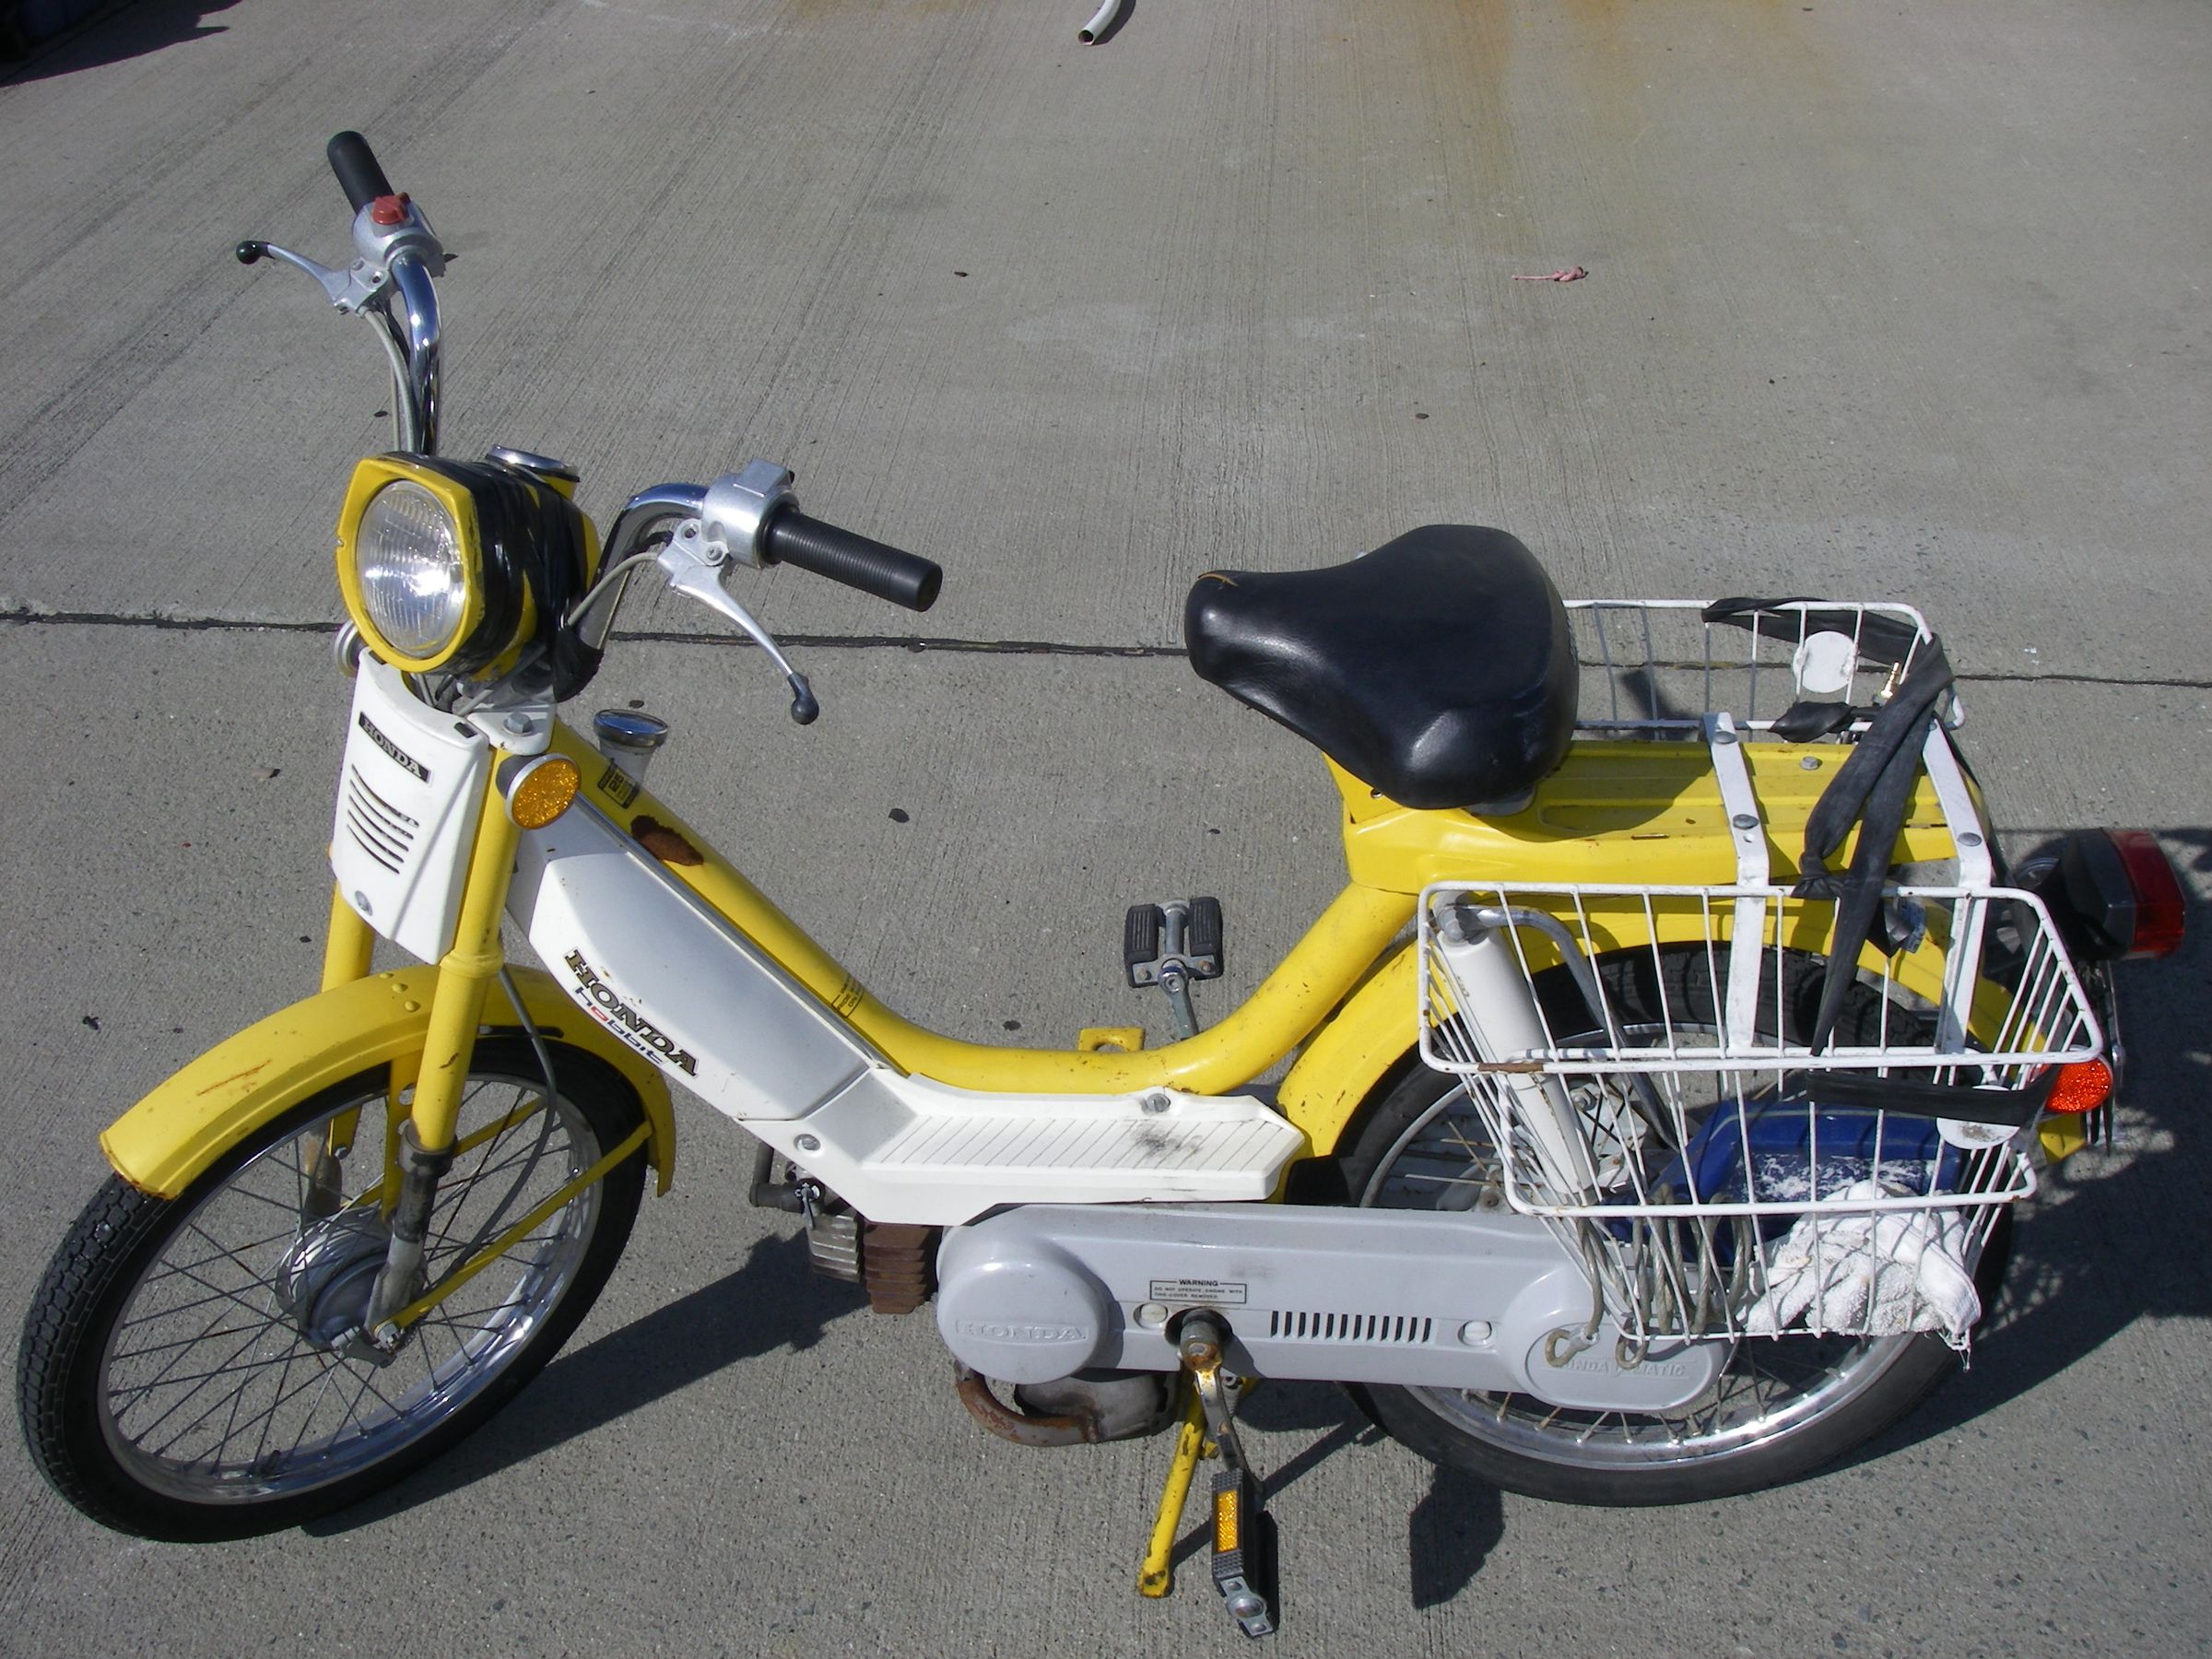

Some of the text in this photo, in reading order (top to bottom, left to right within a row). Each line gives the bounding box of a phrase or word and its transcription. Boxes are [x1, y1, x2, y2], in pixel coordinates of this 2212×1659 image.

[363, 718, 422, 778] HONDA
[564, 949, 698, 1077] HONDA
[575, 986, 664, 1065] hobbit
[961, 1321, 1087, 1339] HONDA
[1565, 1359, 1609, 1372] ONDA
